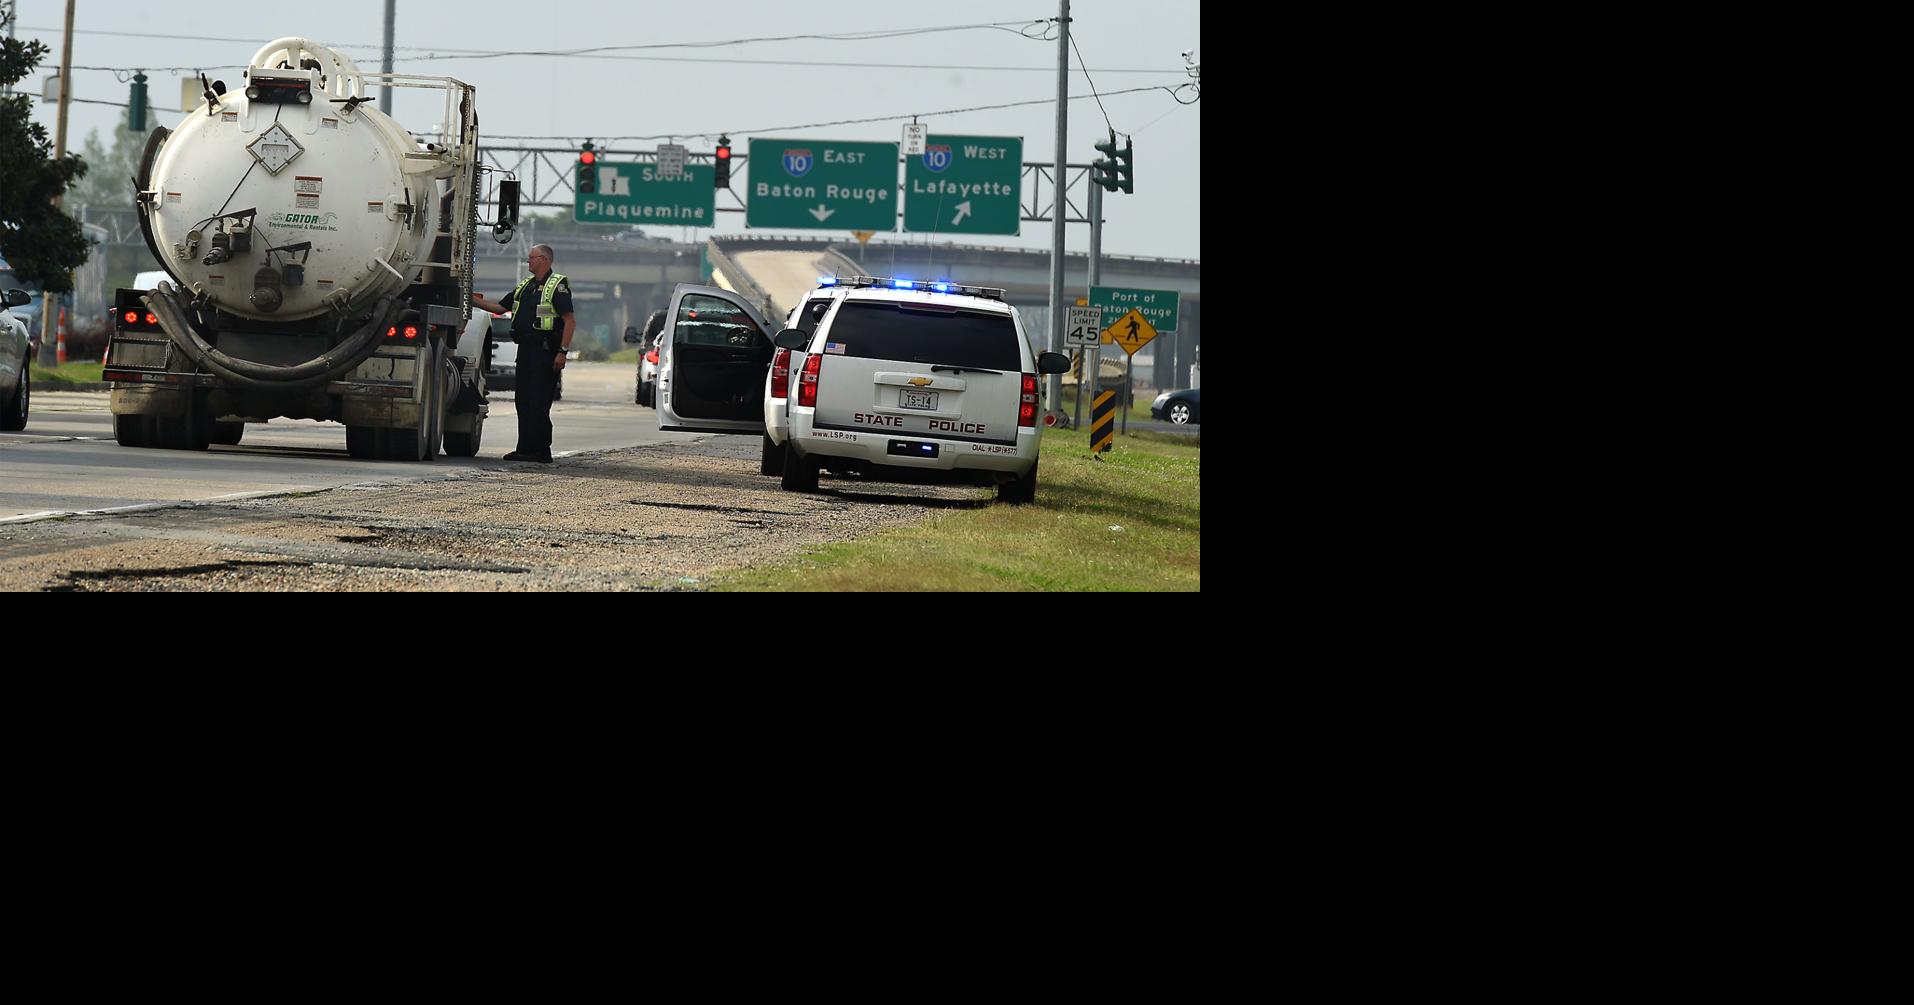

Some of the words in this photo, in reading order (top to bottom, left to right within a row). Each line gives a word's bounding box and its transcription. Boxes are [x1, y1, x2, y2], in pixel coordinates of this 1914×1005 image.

[823, 149, 865, 164] EAST
[928, 151, 946, 168] 10
[963, 145, 1007, 160] WEST
[788, 155, 807, 172] 10
[756, 182, 816, 199] Baton
[826, 184, 888, 204] Rouge
[913, 179, 1012, 198] Lafayette
[584, 201, 705, 219] Plaquemine
[285, 213, 319, 224] GATOR
[1112, 291, 1138, 302] Port
[1143, 293, 1156, 304] of
[1072, 309, 1100, 318] SPEED
[1074, 317, 1096, 326] LIMIT
[1070, 326, 1098, 341] 45
[853, 413, 904, 427] STATE
[928, 419, 986, 435] POLICE
[812, 430, 857, 442] www.LSP.org
